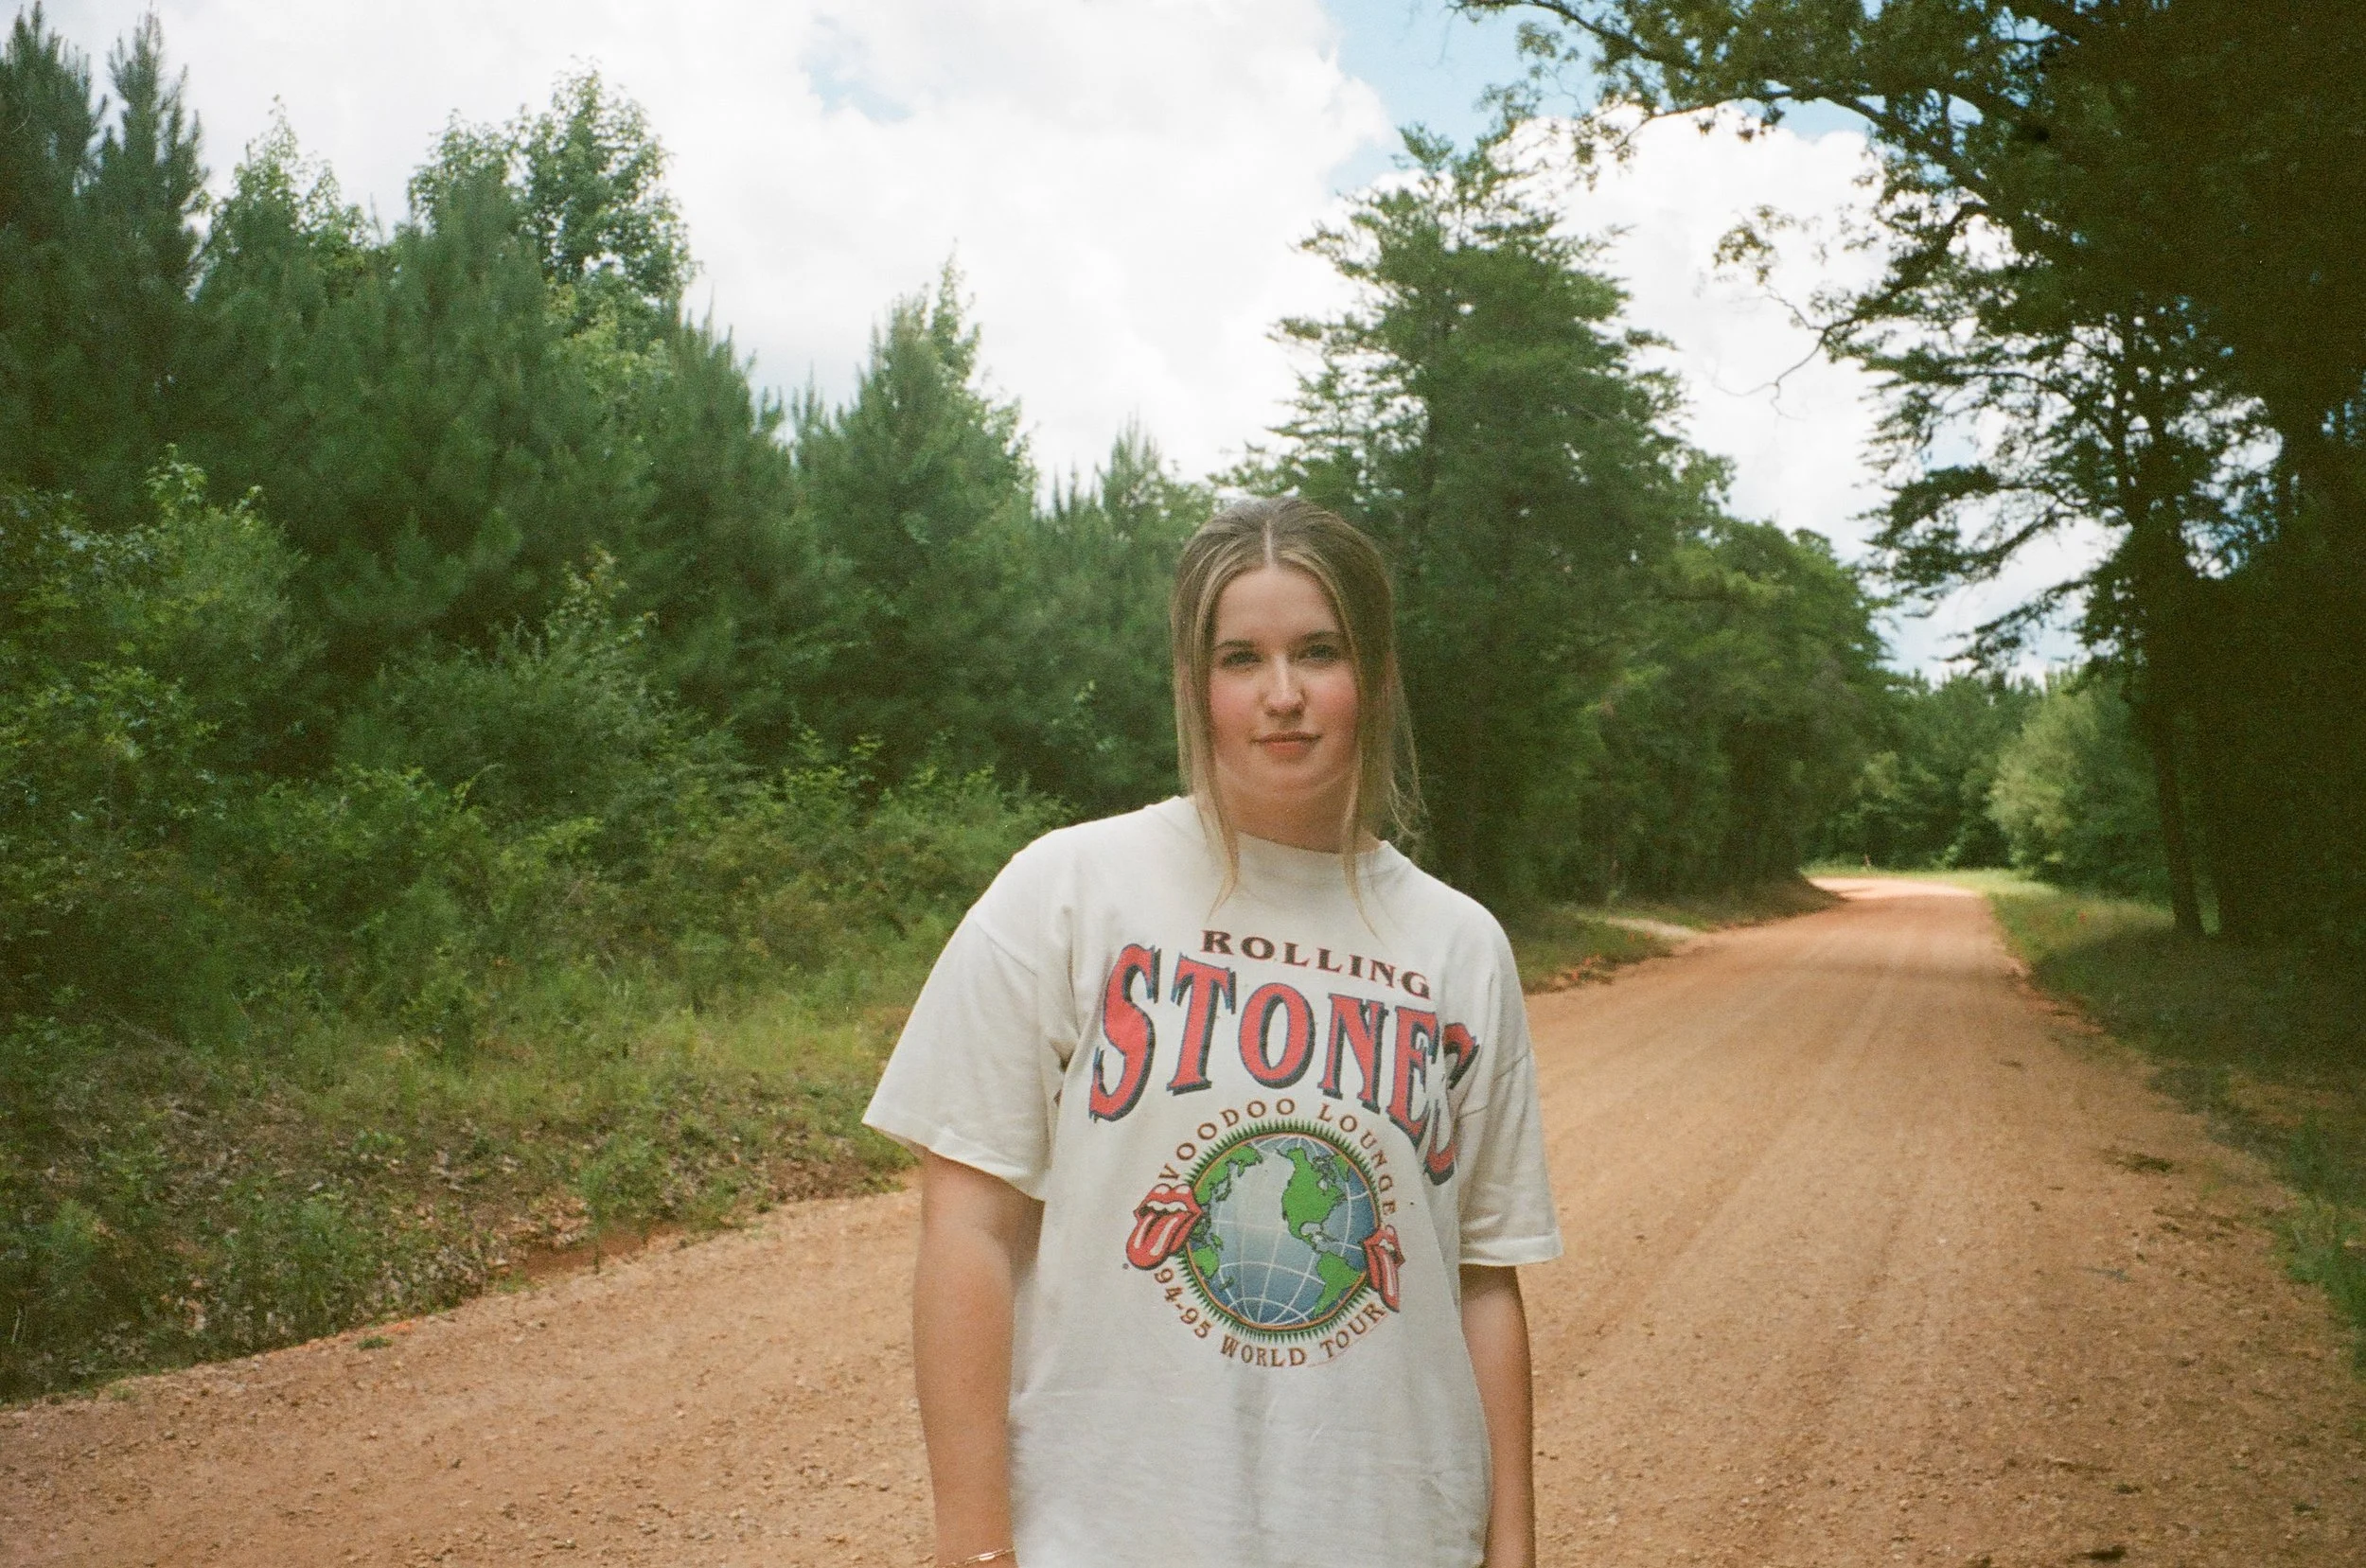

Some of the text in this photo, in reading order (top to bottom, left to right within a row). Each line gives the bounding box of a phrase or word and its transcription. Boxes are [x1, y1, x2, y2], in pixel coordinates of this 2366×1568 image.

[1200, 929, 1432, 1000] ROLLING
[1158, 1098, 1397, 1216] VOODOO LOUNGE
[1220, 1335, 1306, 1366] WORLD
[1319, 1301, 1387, 1360] TOUR
